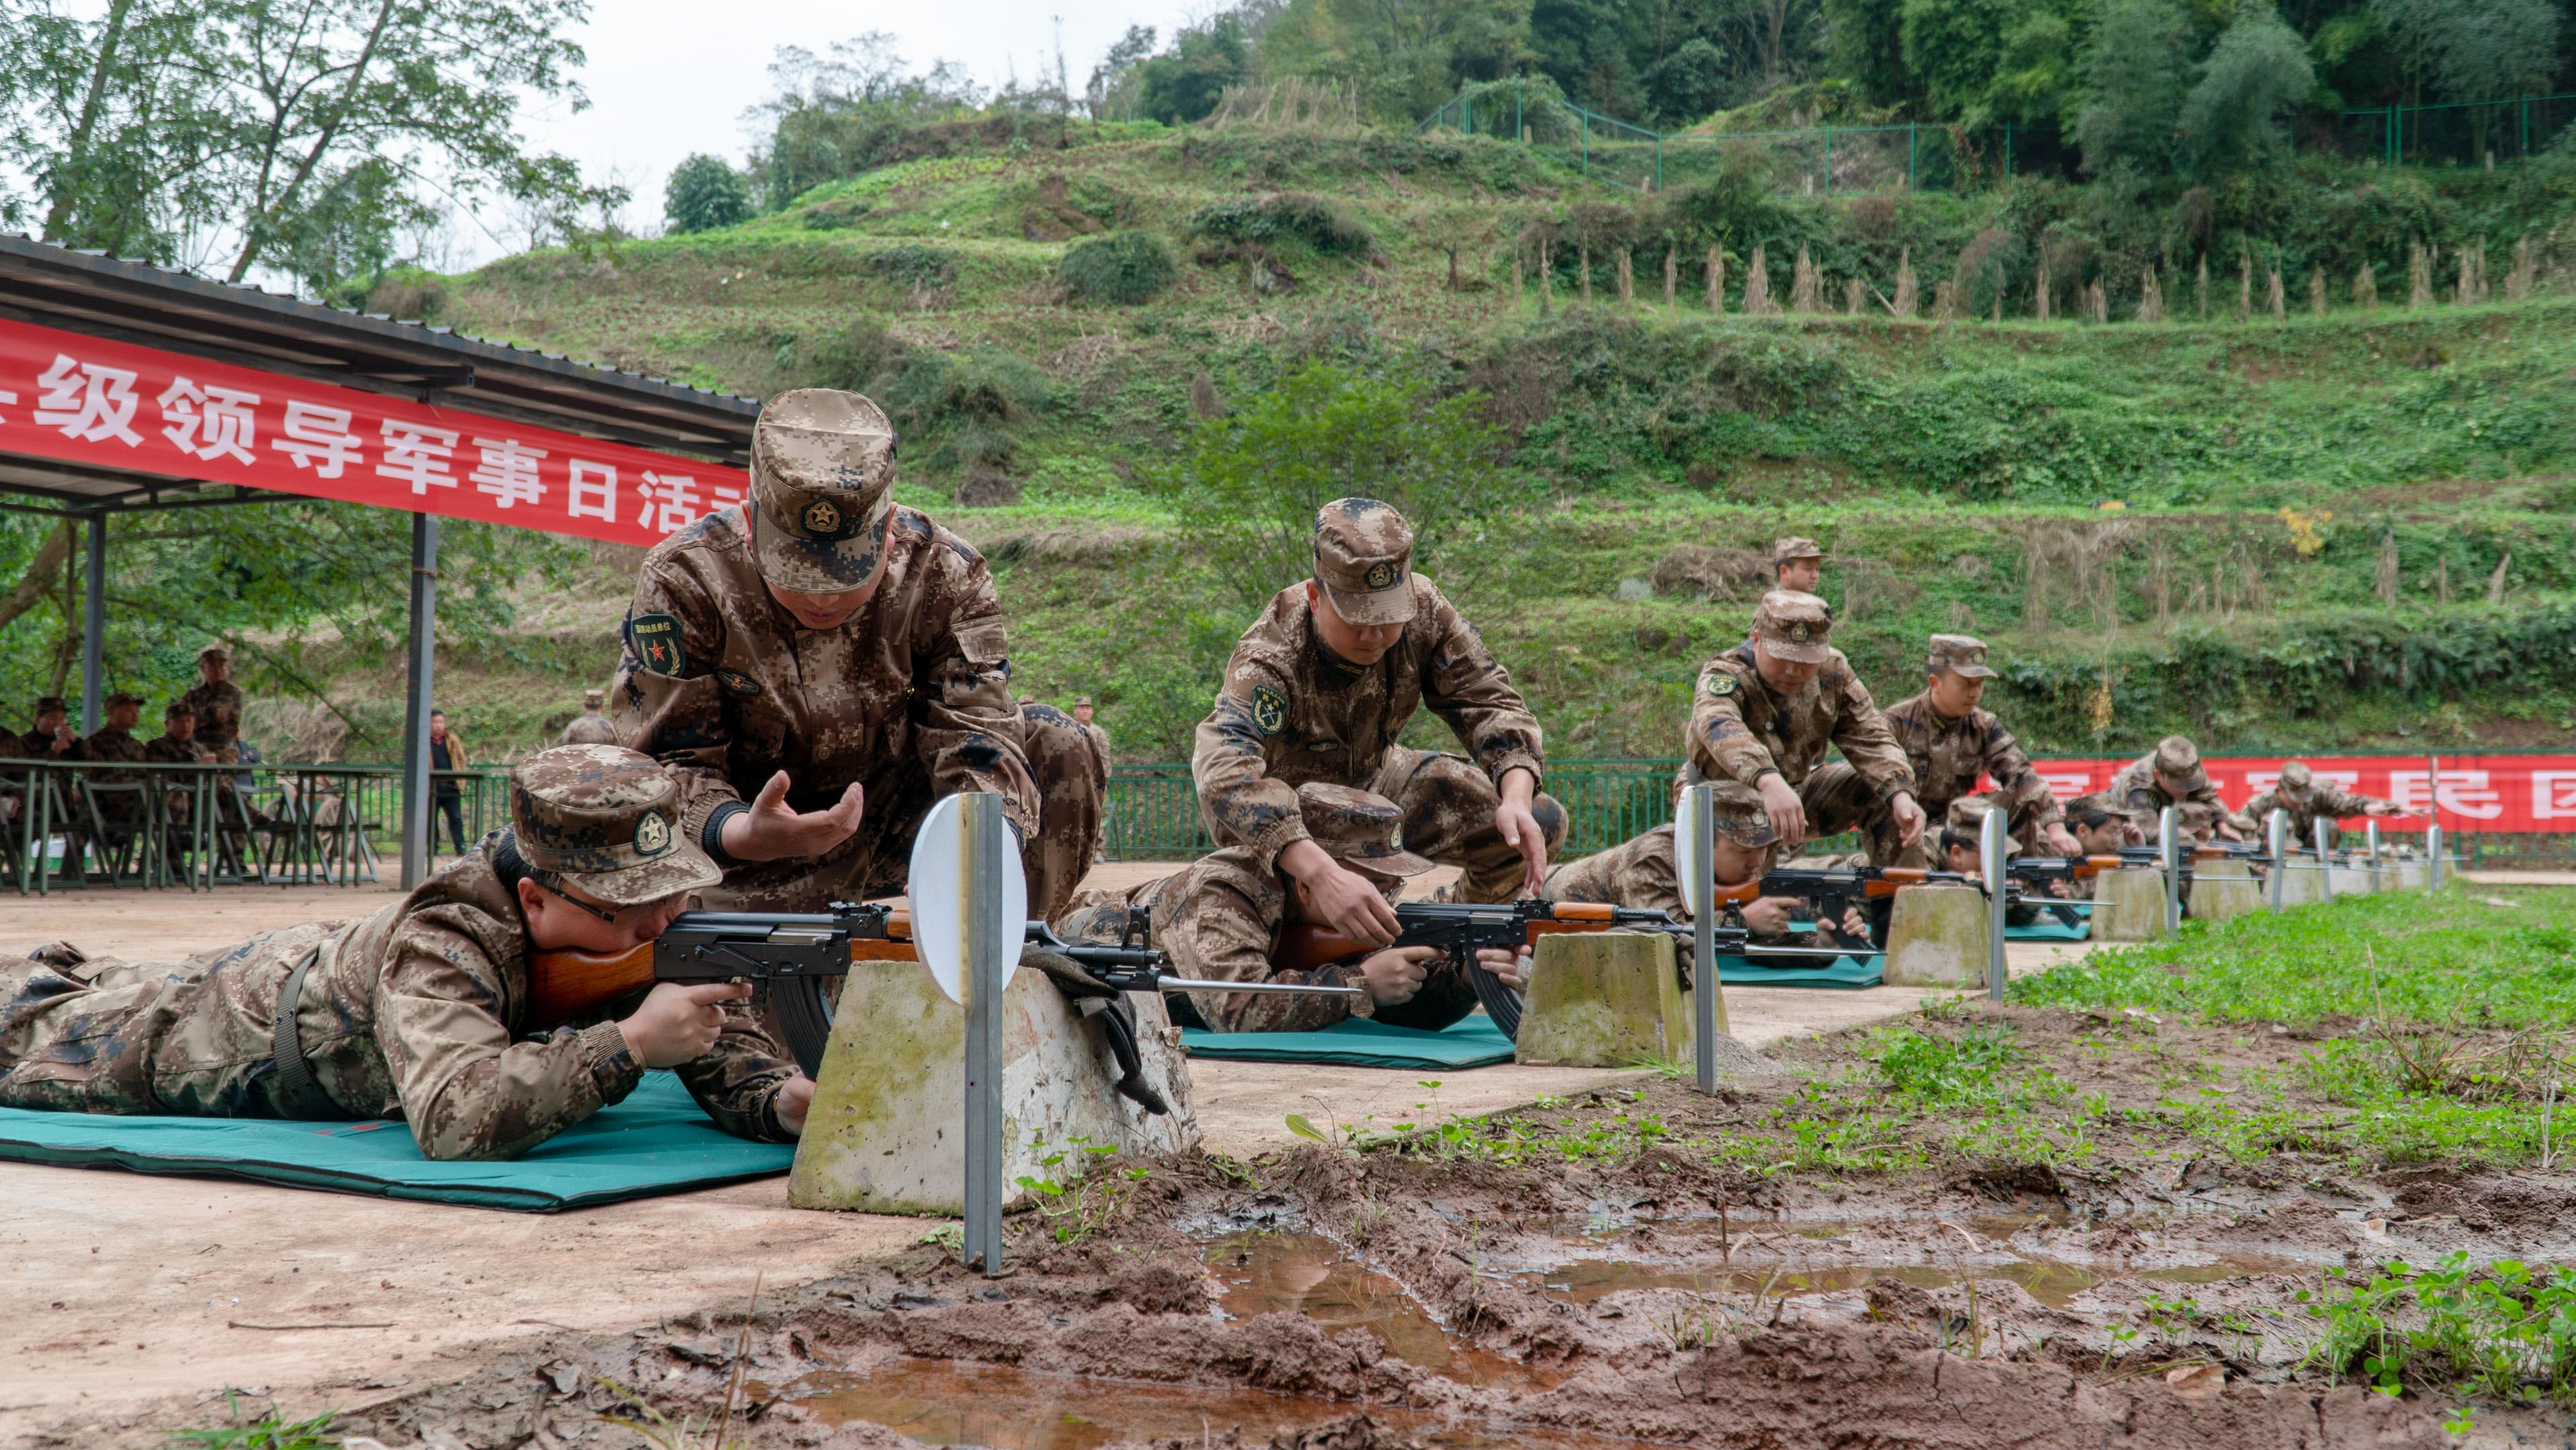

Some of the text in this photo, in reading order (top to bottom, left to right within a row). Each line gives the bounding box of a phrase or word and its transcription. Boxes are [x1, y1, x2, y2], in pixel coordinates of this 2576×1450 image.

[0, 353, 750, 534] 级领导军事日活
